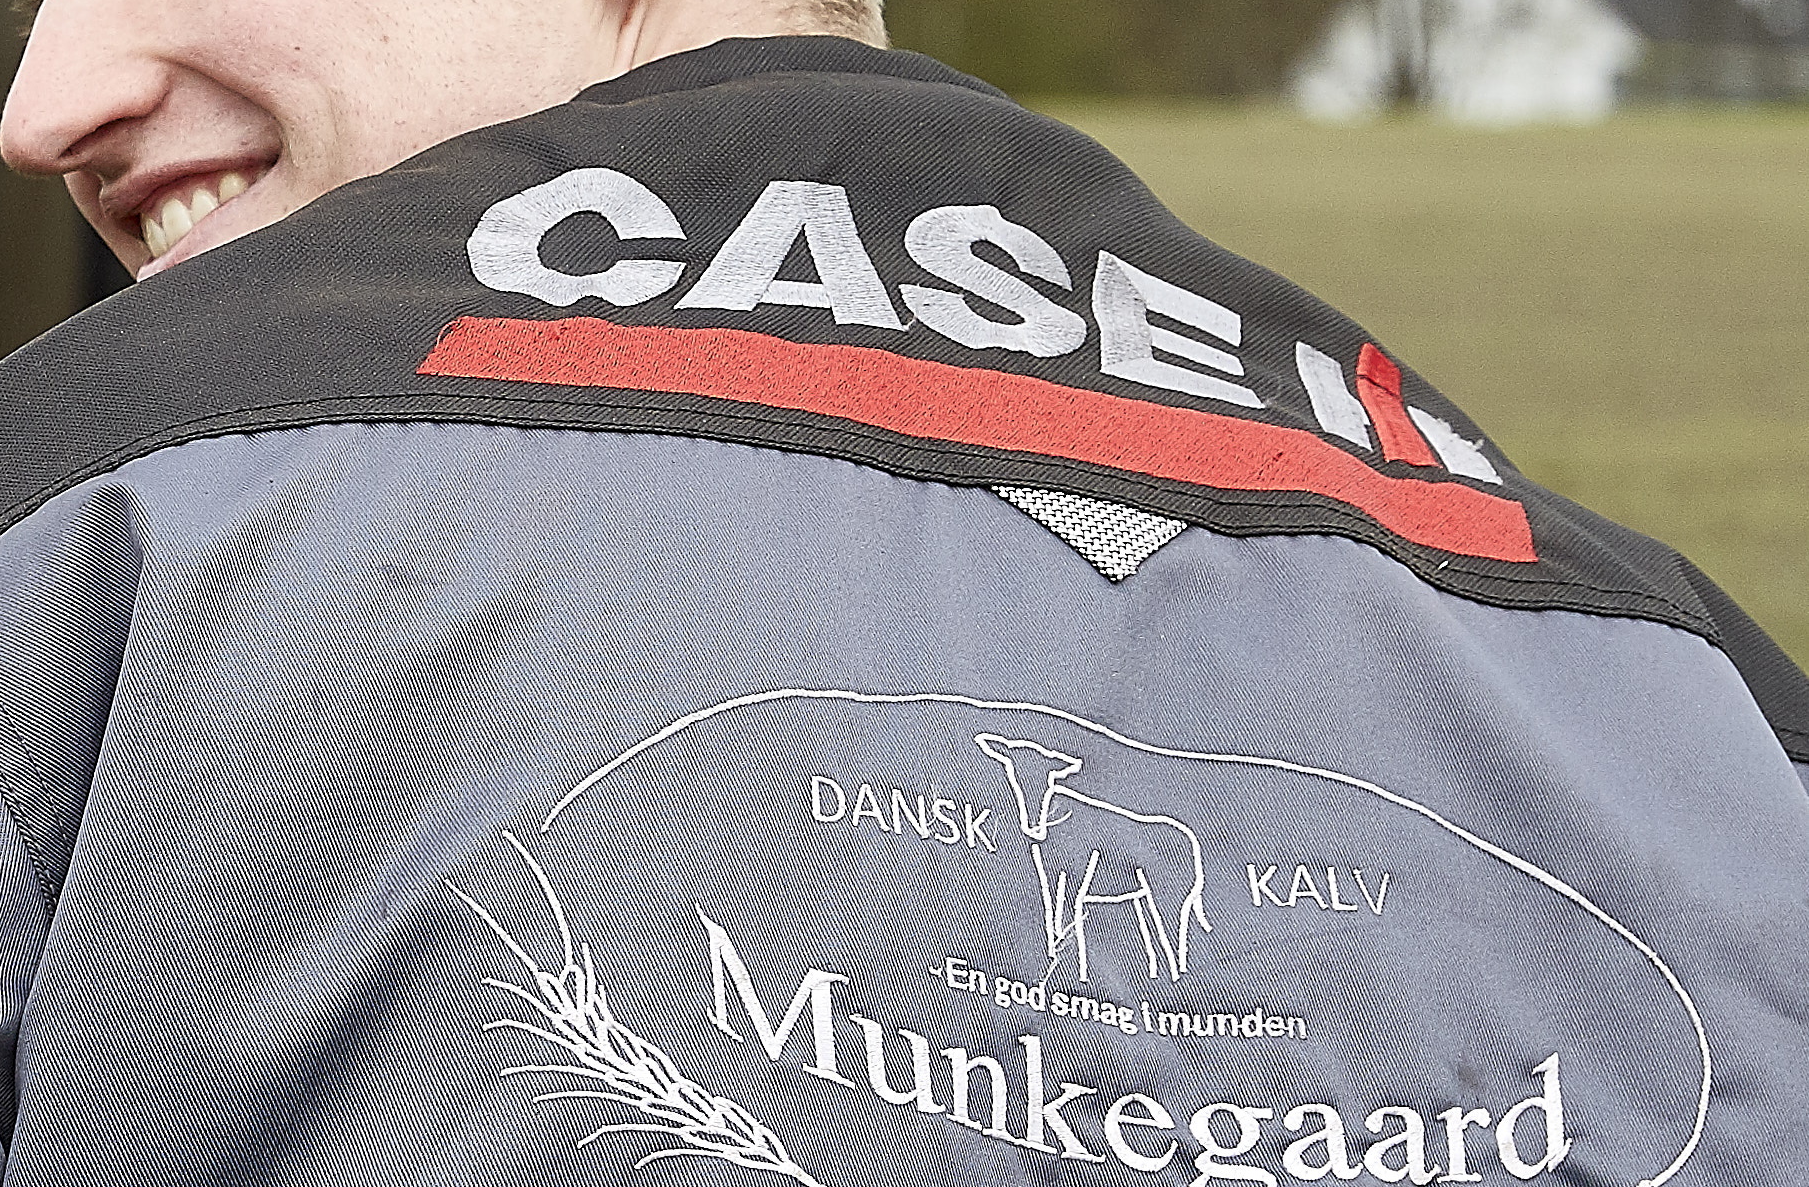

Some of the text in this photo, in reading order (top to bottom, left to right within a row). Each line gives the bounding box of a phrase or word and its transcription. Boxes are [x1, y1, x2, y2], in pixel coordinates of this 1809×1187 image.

[466, 167, 1266, 409] CASE
[809, 774, 998, 854] DANSK
[1245, 862, 1392, 915] KALV
[694, 901, 1574, 1187] Munkegaard
[993, 975, 1047, 1013] god
[1050, 991, 1140, 1035] smag
[1139, 1000, 1157, 1034] i
[1157, 1007, 1309, 1040] munden
